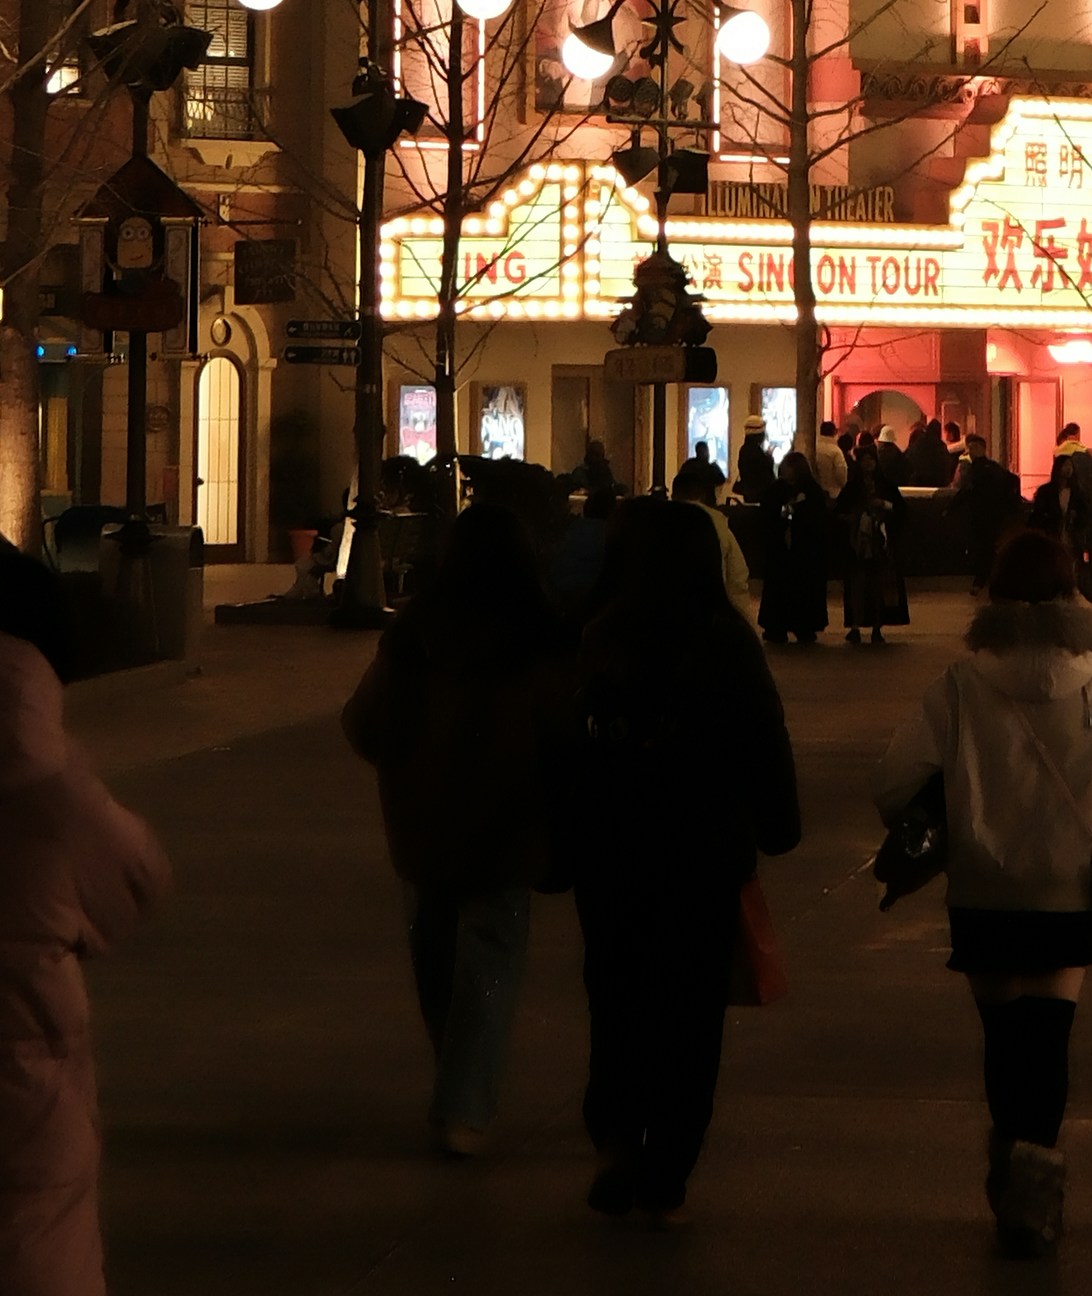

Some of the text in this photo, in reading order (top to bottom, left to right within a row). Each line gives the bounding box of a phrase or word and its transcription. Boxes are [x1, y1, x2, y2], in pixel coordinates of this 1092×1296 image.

[702, 180, 895, 222] ILLUMINATN THEATER
[439, 251, 527, 285] ING
[817, 255, 857, 295] ON
[867, 256, 942, 297] TOUR
